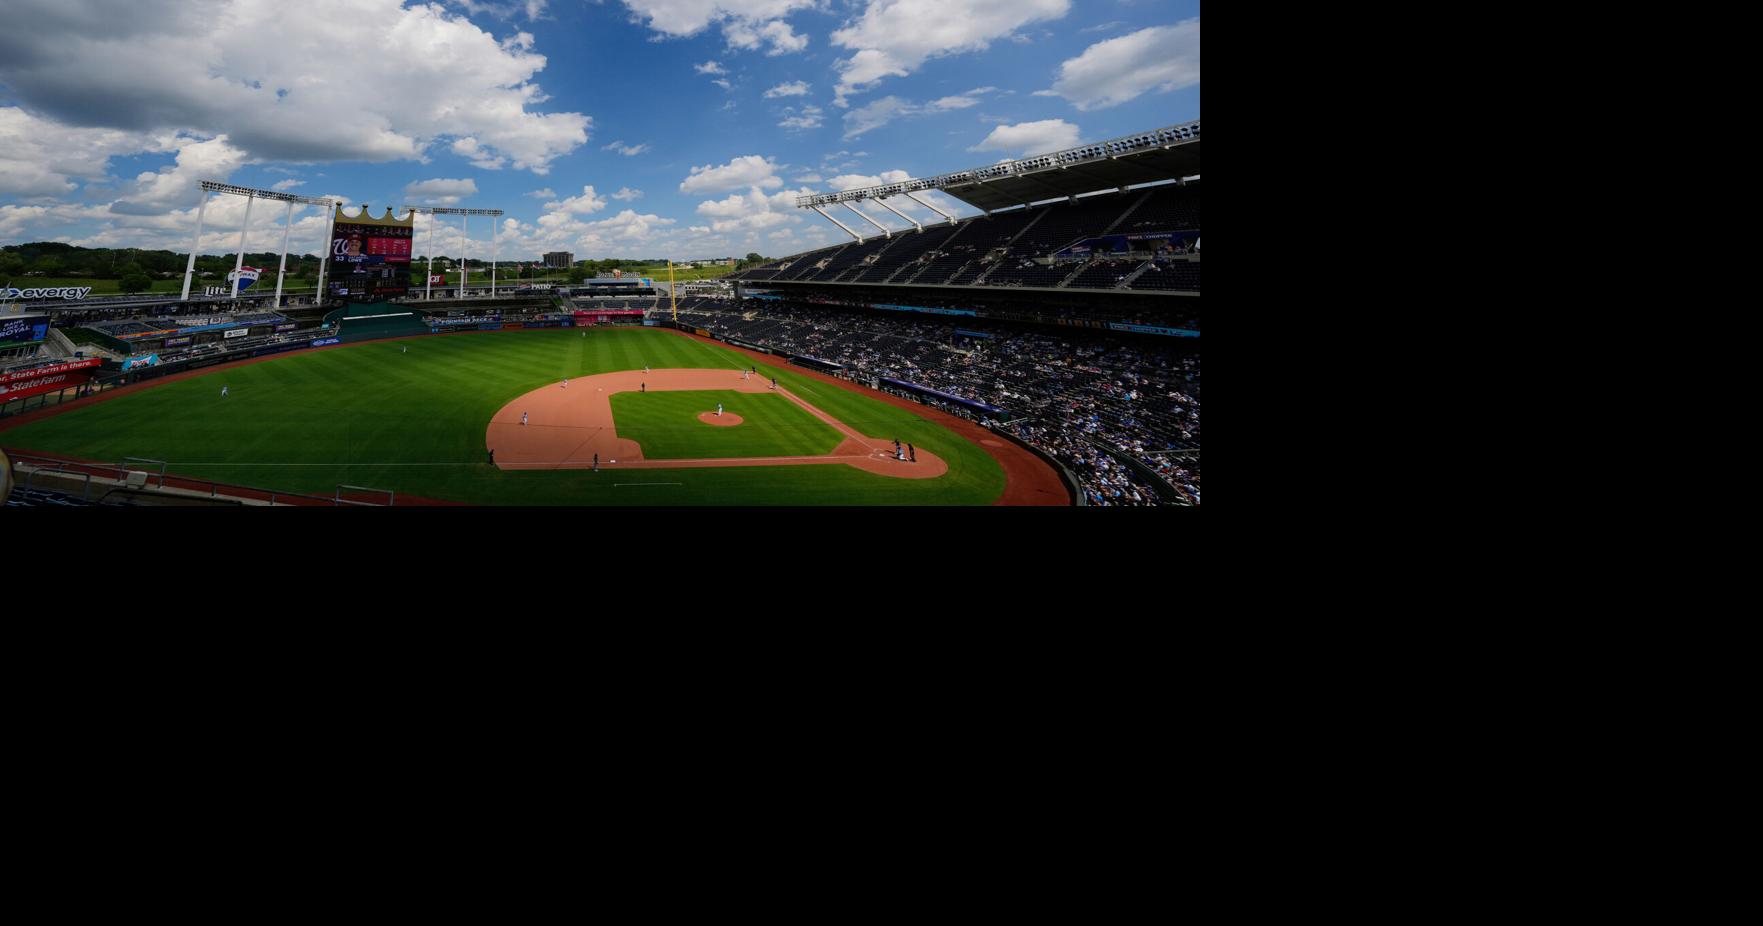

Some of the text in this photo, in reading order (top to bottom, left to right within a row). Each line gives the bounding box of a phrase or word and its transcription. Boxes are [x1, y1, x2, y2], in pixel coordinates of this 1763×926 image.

[22, 286, 92, 300] evergy
[10, 370, 35, 380] State
[37, 366, 59, 375] Farm
